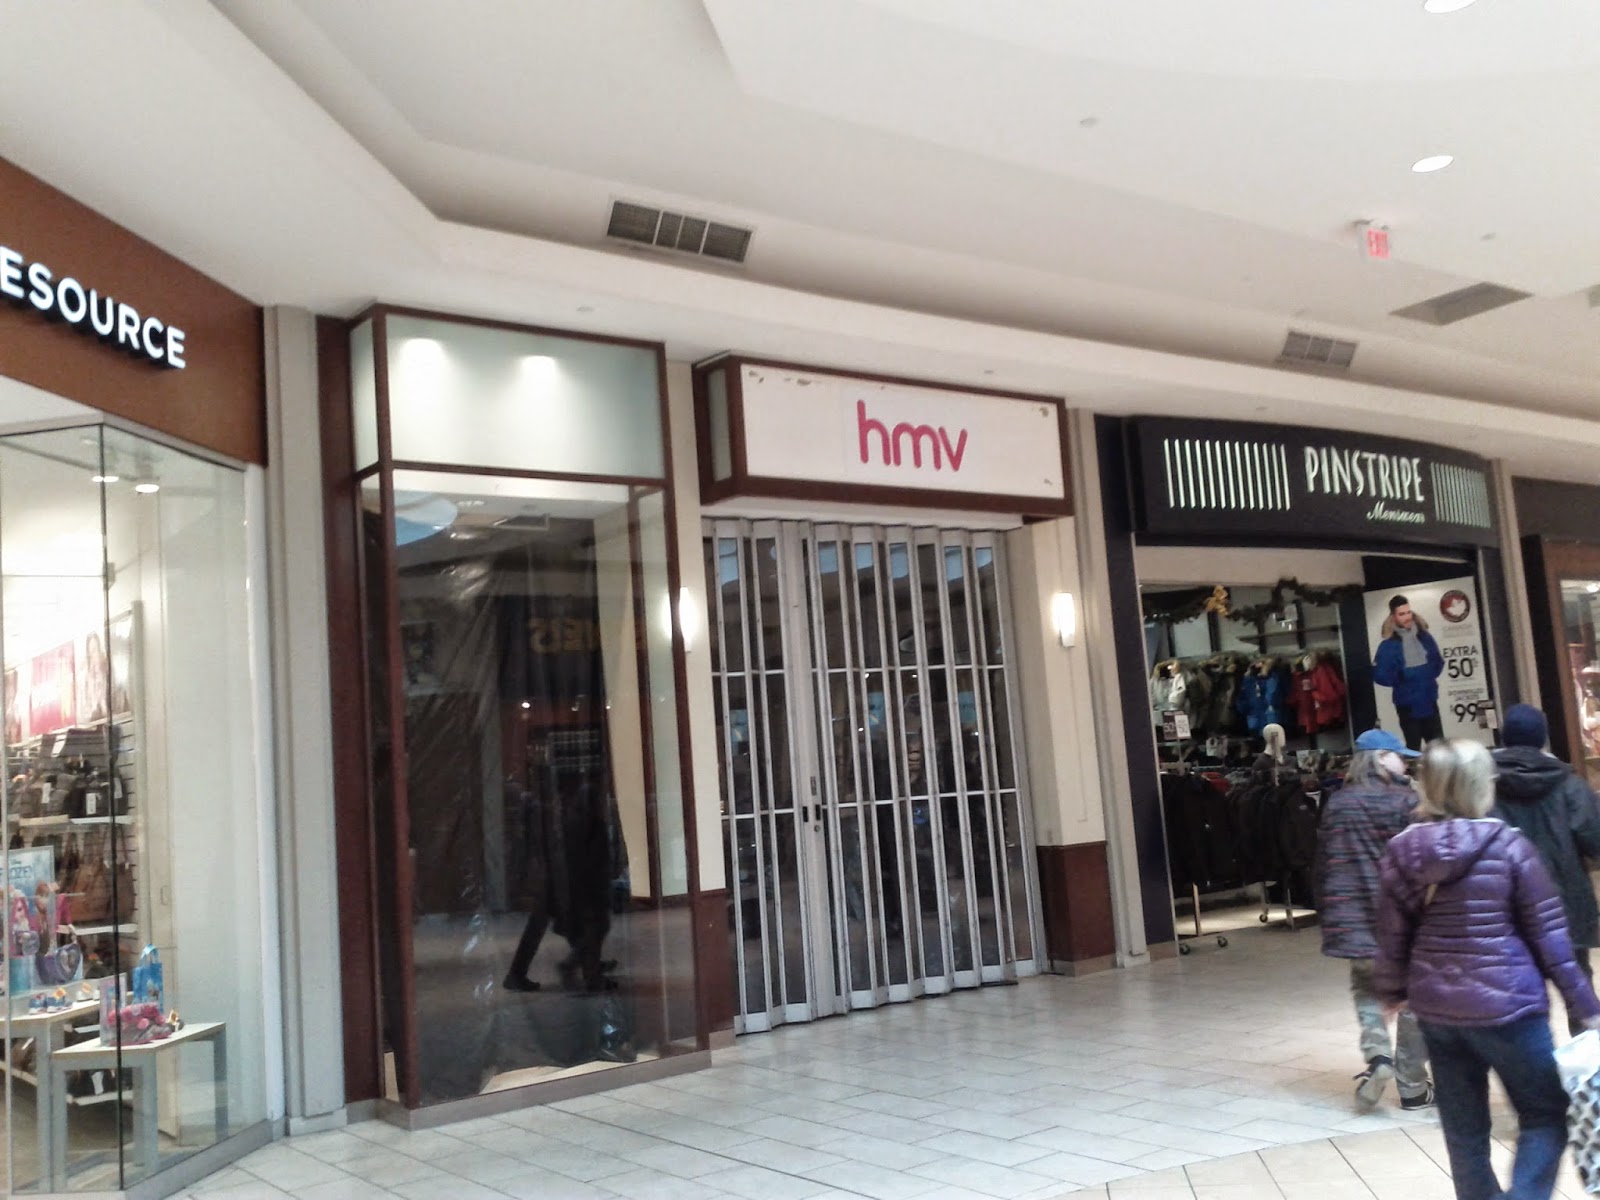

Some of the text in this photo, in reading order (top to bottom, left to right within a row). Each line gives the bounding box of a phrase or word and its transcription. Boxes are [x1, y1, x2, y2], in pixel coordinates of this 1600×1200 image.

[0, 245, 187, 369] ESOURCE
[857, 399, 968, 472] hmv
[1304, 445, 1425, 502] PINSTRIPE
[1443, 645, 1479, 658] EXTRA
